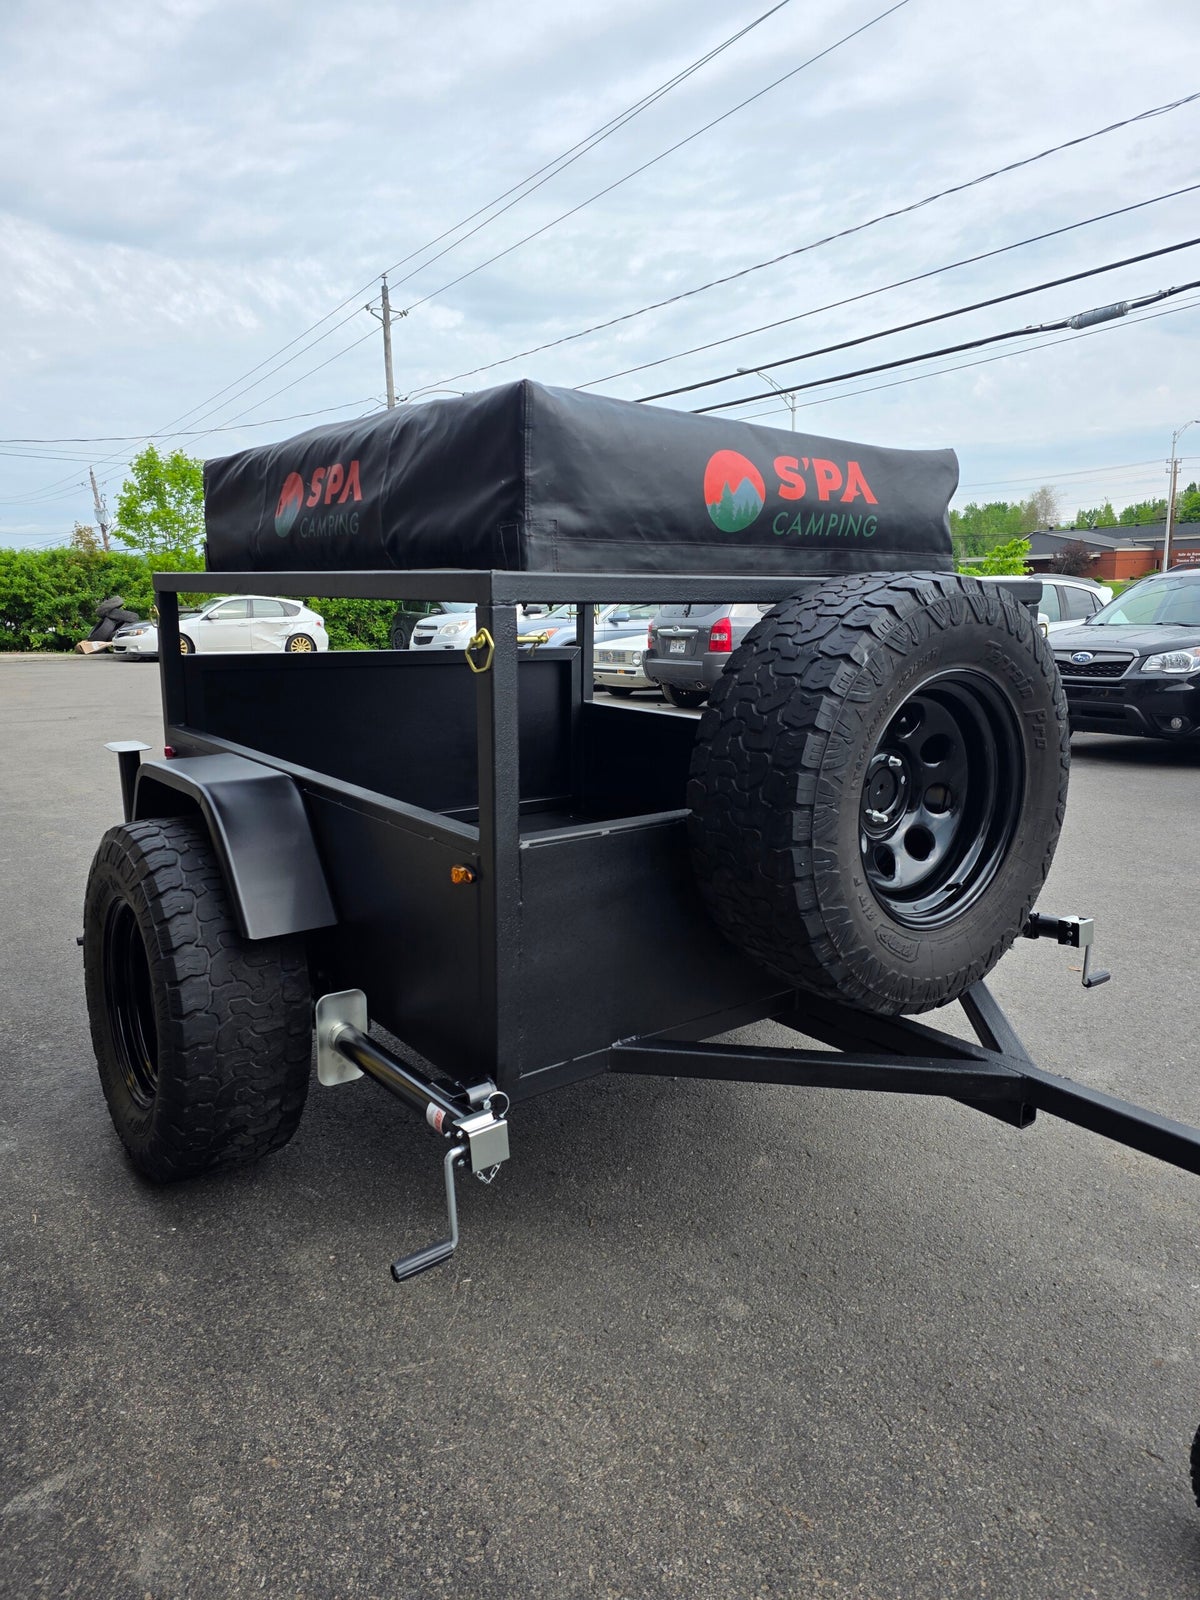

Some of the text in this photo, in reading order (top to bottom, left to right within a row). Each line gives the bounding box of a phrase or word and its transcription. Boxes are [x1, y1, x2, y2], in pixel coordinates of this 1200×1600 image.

[307, 460, 362, 507] S'PA
[773, 456, 878, 504] S'PA
[301, 512, 359, 537] CAMPING
[773, 511, 878, 537] CAMPING
